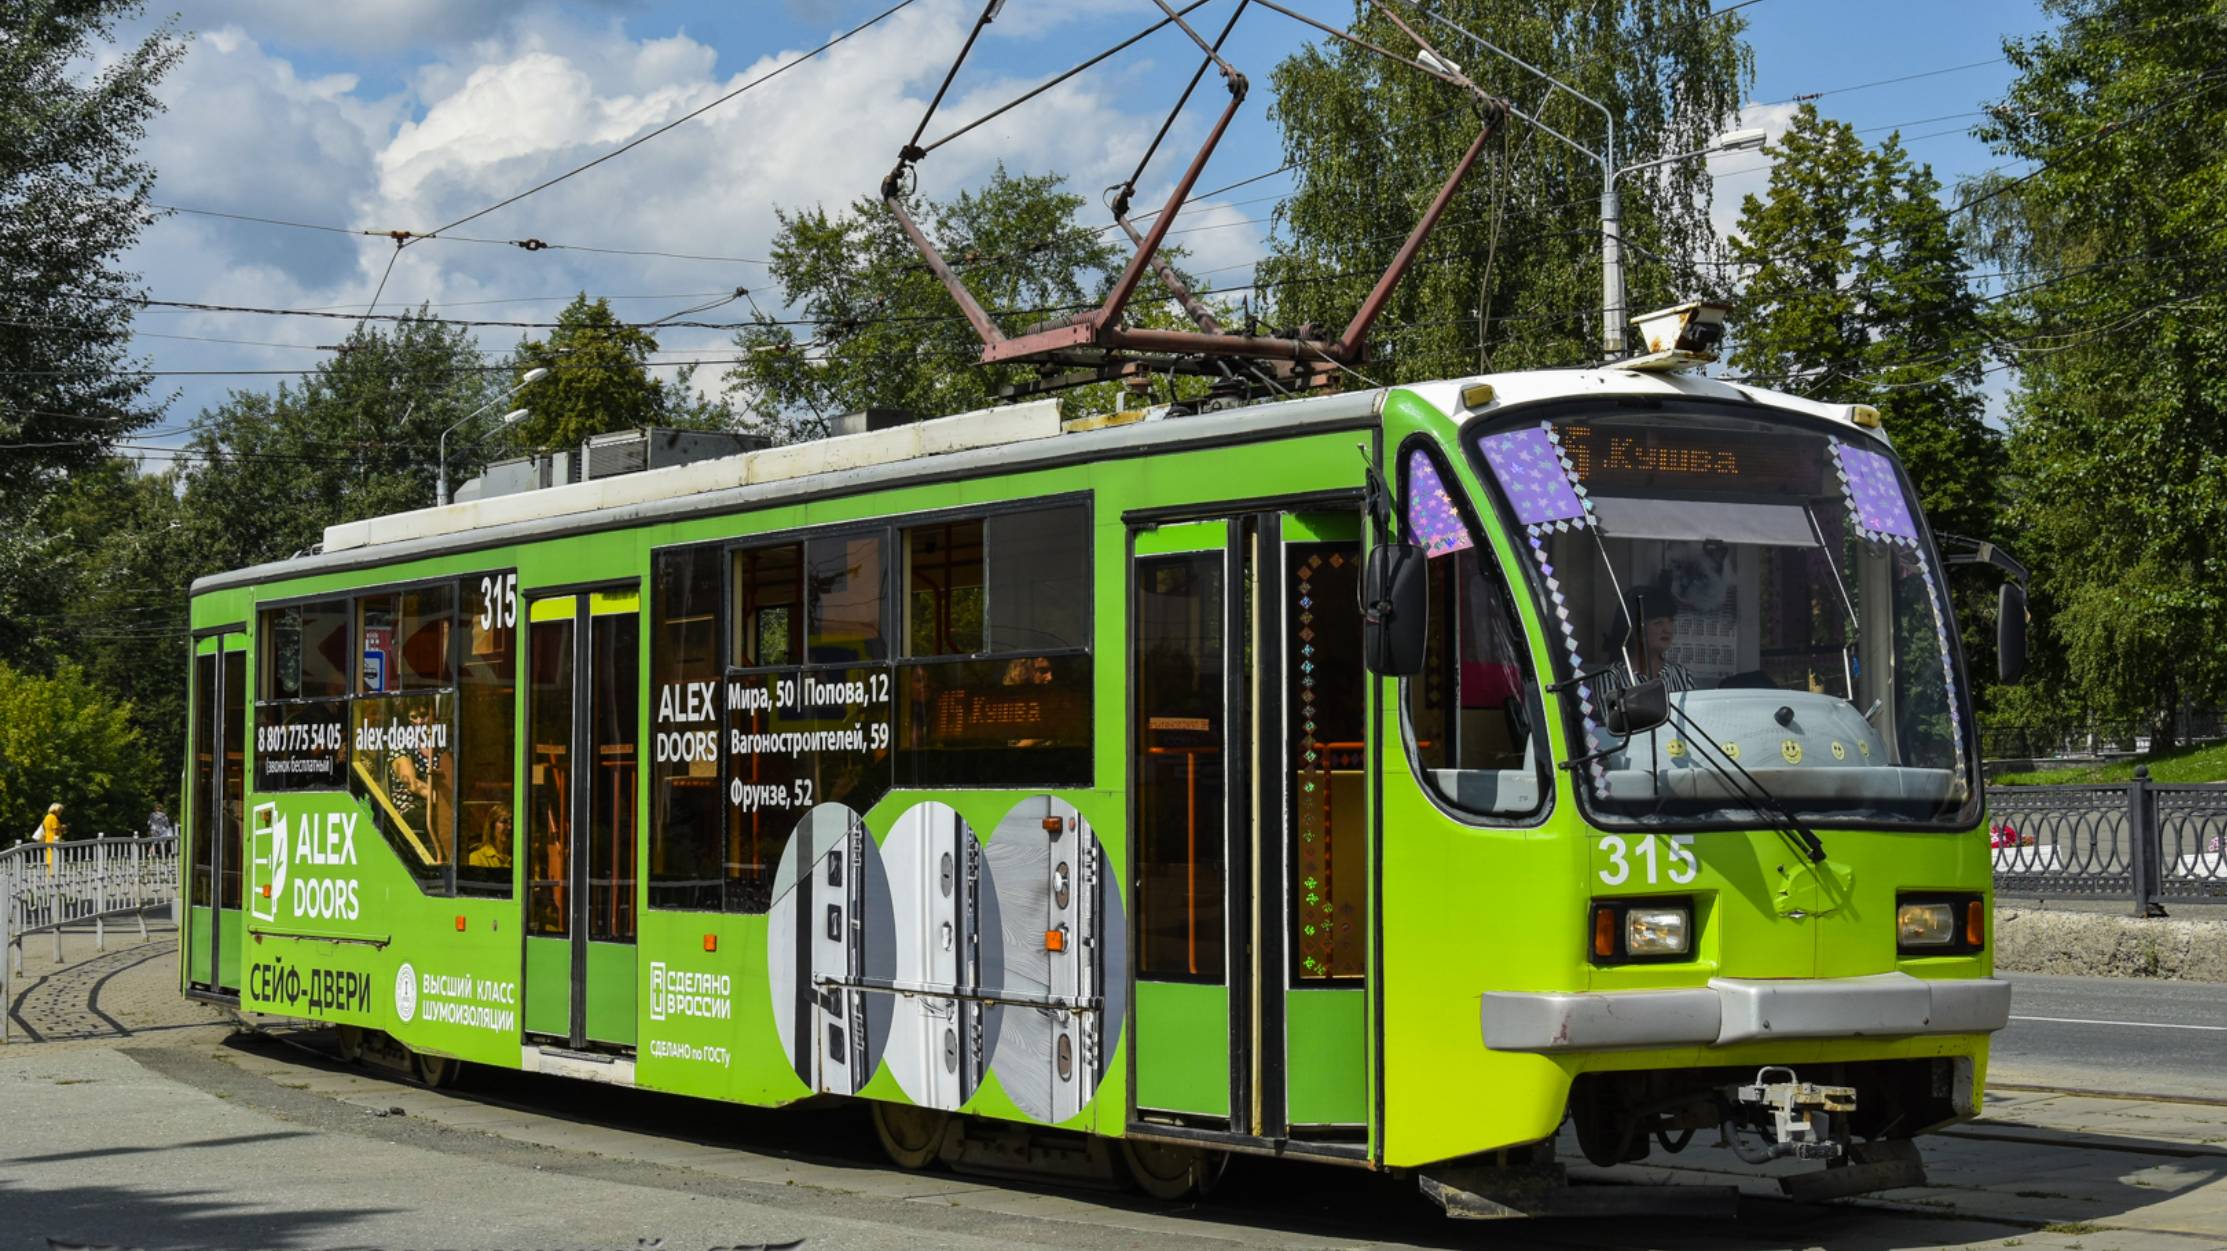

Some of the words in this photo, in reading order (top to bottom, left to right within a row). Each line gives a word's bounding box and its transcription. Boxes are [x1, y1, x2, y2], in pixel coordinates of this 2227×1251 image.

[480, 574, 517, 631] 315
[658, 681, 716, 722] ALEX
[728, 682, 772, 715] Мира,
[776, 680, 793, 708] 50
[258, 727, 265, 752] 8
[289, 725, 308, 750] 775
[311, 724, 325, 749] 54
[327, 723, 341, 747] 05
[355, 717, 447, 751] alex-doors.ru
[657, 731, 718, 763] DOORS
[731, 723, 868, 759] Вагоностроителей,
[870, 723, 889, 750] 59
[730, 777, 791, 813] Фрунзе,
[794, 779, 813, 806] 52
[295, 813, 358, 865] ALEX
[1599, 834, 1697, 885] 315
[293, 878, 359, 921] DOORS
[250, 956, 371, 1016] СЕЙФ-ДВЕРИ
[422, 974, 472, 998] ВЫСШИЙ
[476, 980, 515, 1004] КЛАСС
[667, 971, 731, 996] СДЕЛАНО
[422, 1000, 514, 1033] ШУМОИЗОЛЯЦИИ
[650, 1040, 691, 1059] СДЕЛАНО
[692, 1049, 702, 1061] по
